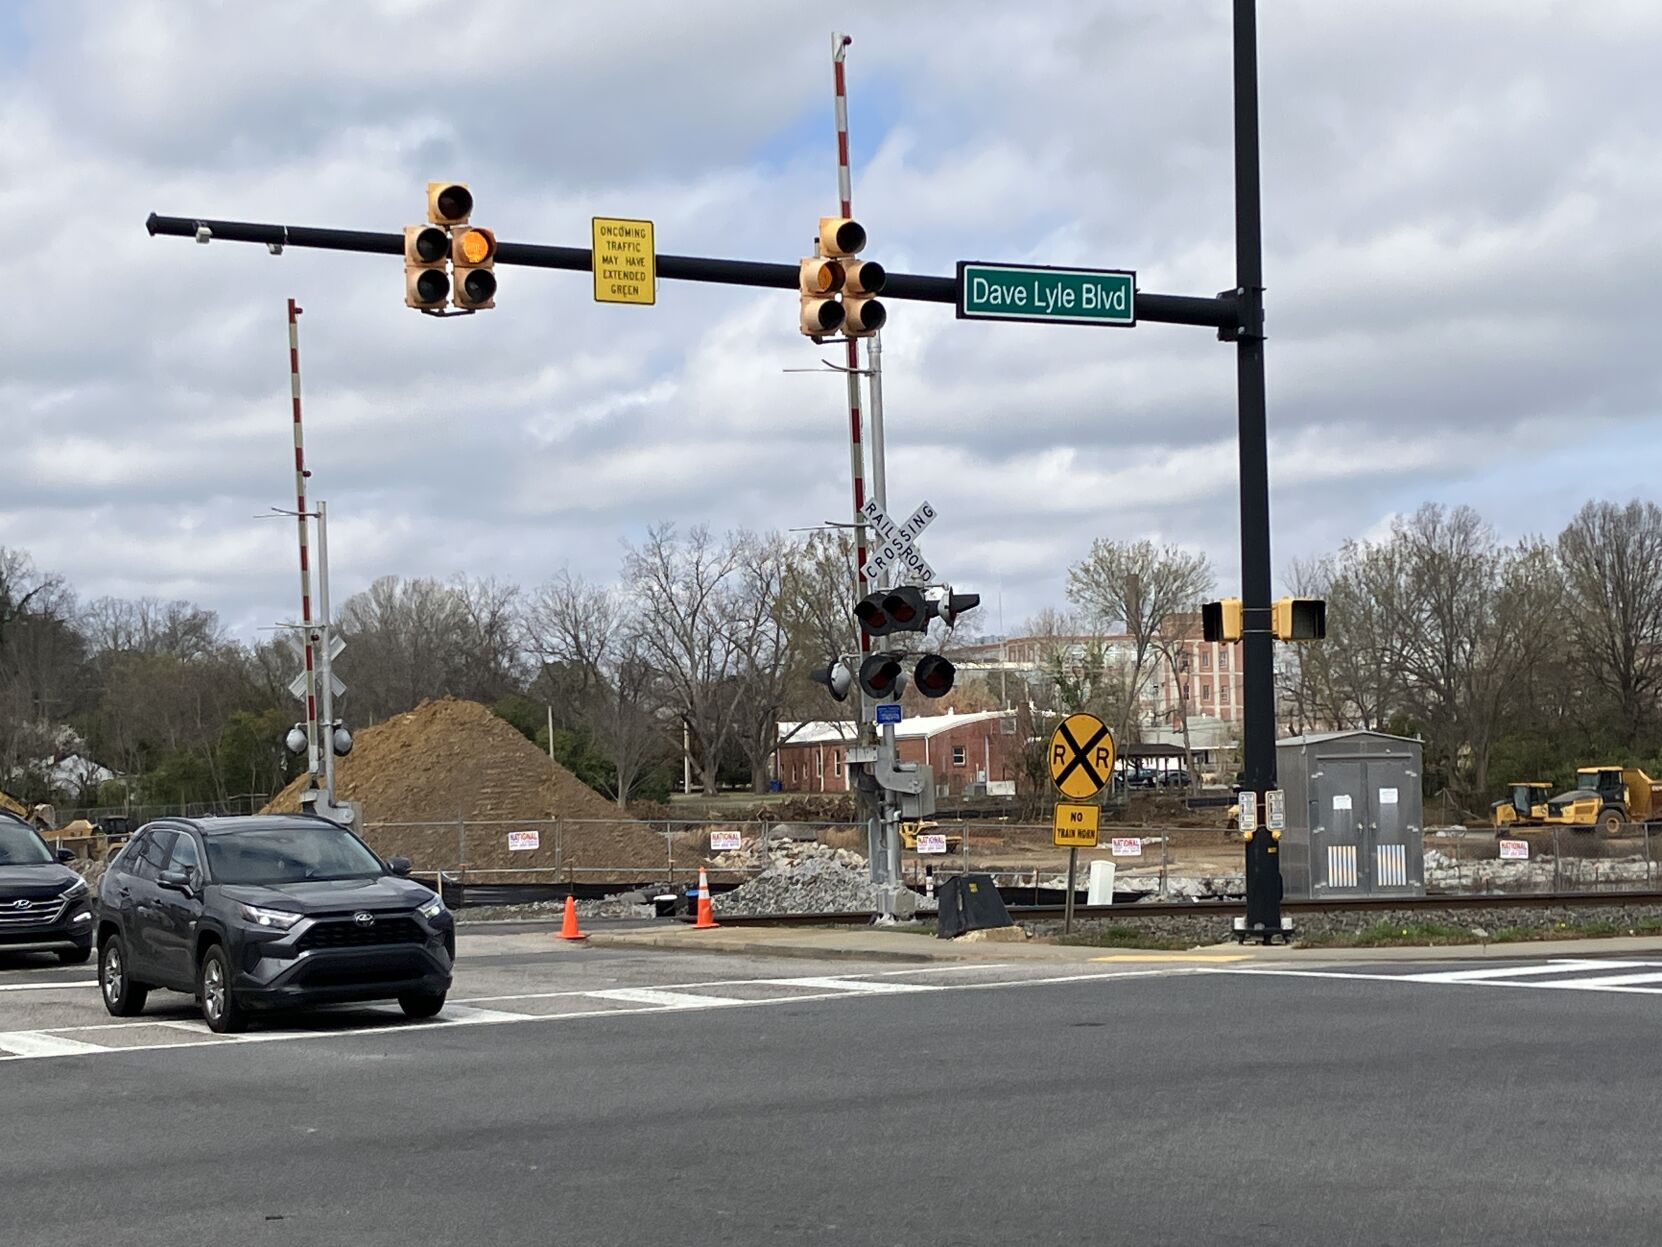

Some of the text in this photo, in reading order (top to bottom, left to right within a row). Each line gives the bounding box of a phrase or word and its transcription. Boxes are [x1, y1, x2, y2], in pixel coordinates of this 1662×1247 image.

[600, 226, 646, 239] ONCOMING
[606, 240, 641, 253] TRAFFIC
[602, 255, 646, 267] MAY HAVE
[603, 269, 646, 282] EXTENDED
[610, 284, 639, 296] GREEN
[973, 277, 1125, 313] Dave Lyle Blvd
[866, 505, 934, 578] CROSSING
[1070, 812, 1083, 823] NO
[1057, 828, 1095, 839] TRAIN HORN
